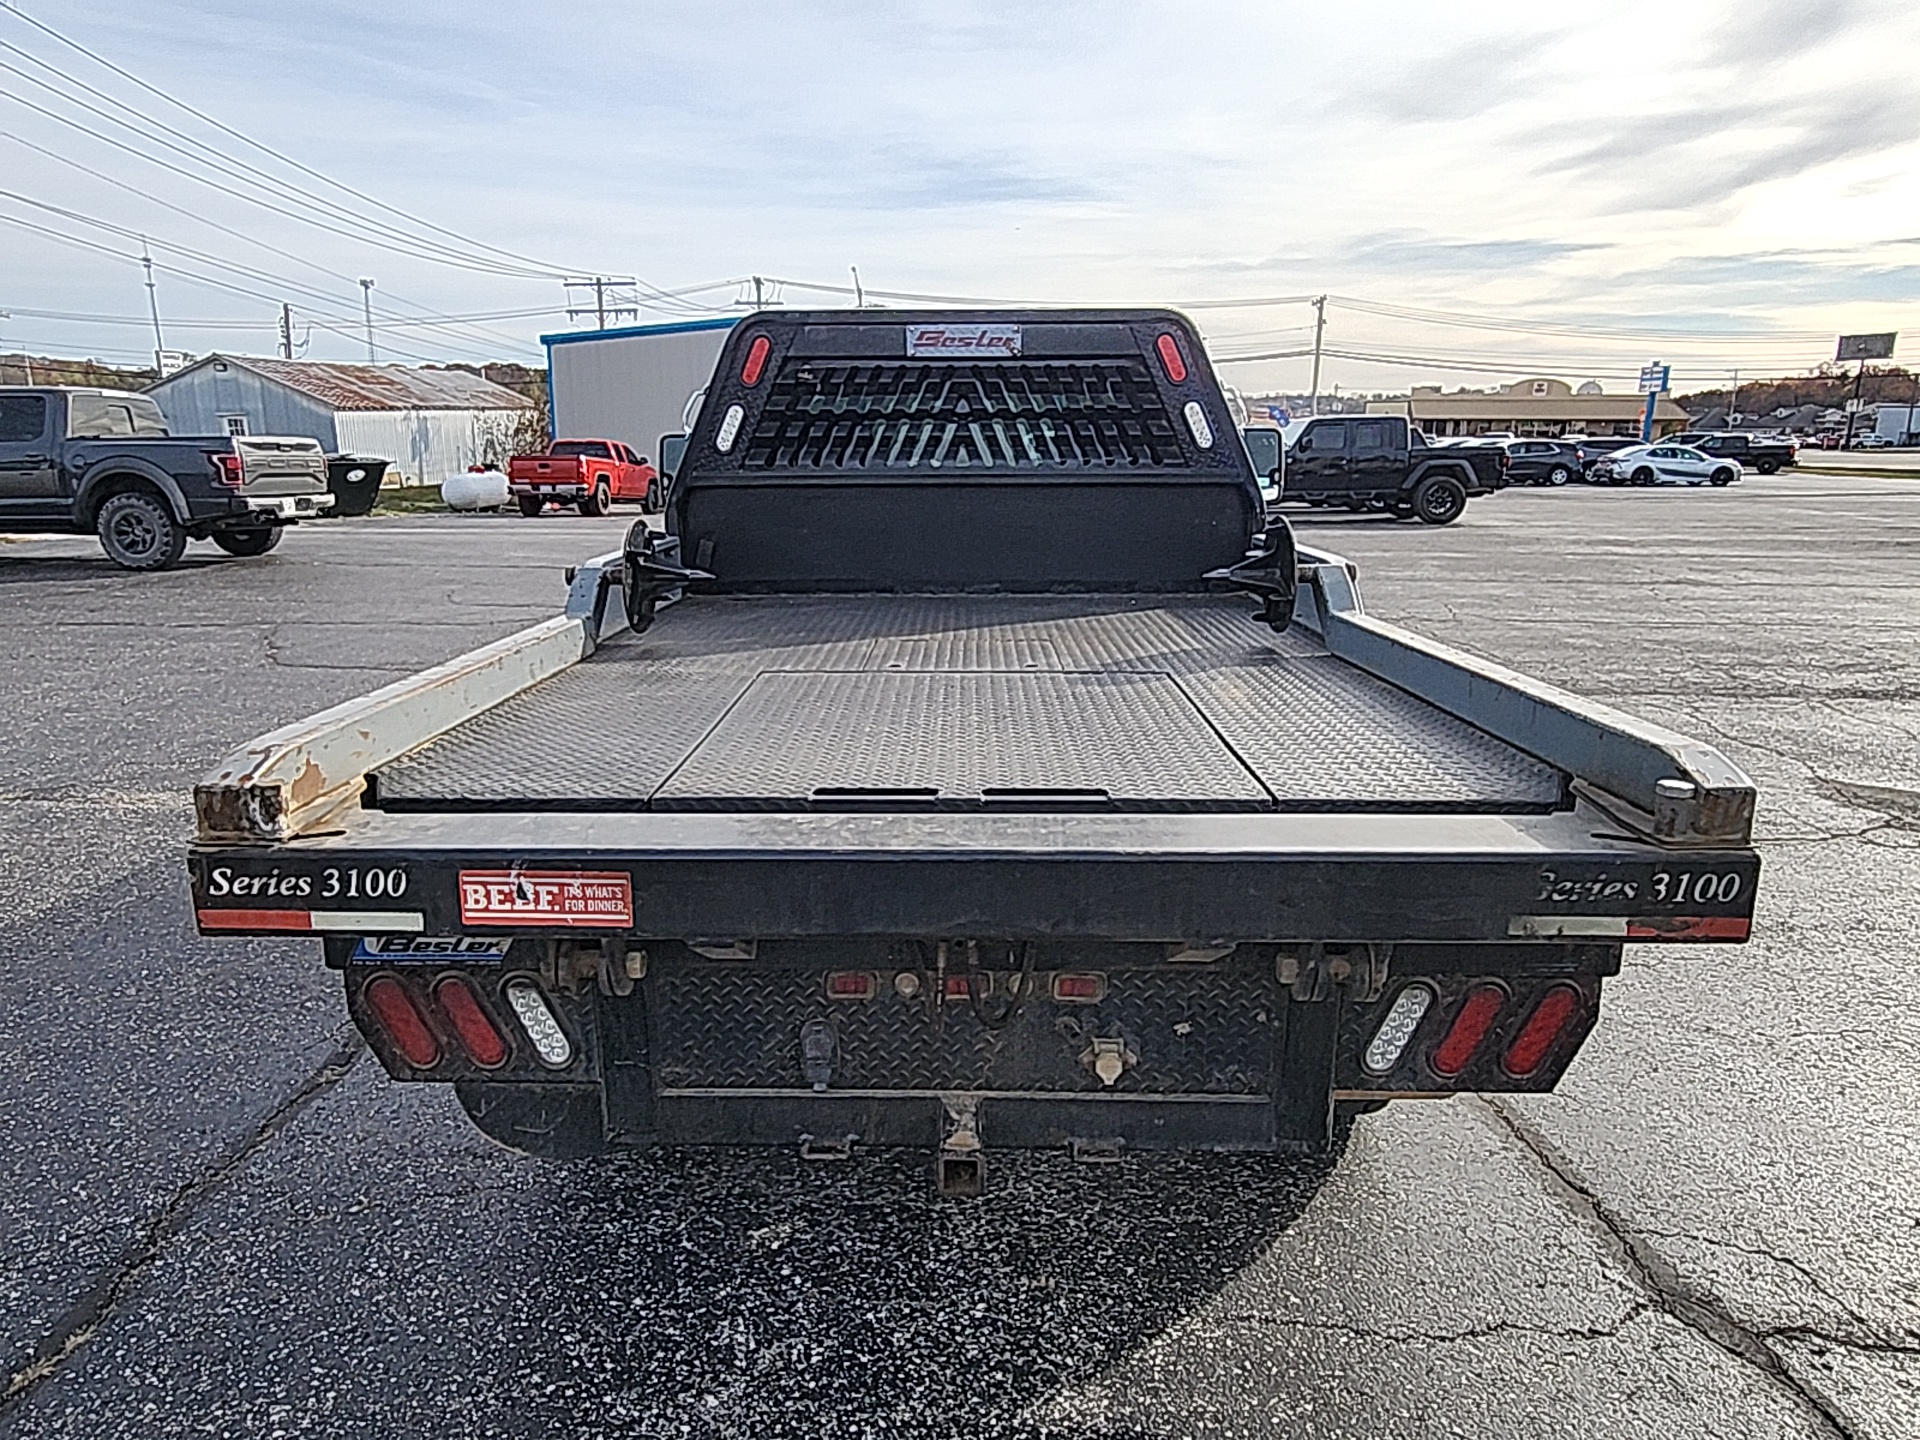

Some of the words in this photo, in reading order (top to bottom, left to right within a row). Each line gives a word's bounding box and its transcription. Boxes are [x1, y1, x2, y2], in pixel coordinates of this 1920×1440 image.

[912, 329, 1016, 348] Besler
[208, 867, 312, 896] Series
[321, 868, 407, 898] 3100
[1651, 872, 1741, 902] 3100
[564, 900, 586, 912] FOR
[587, 900, 629, 914] DINNER.
[377, 937, 502, 954] Besler
